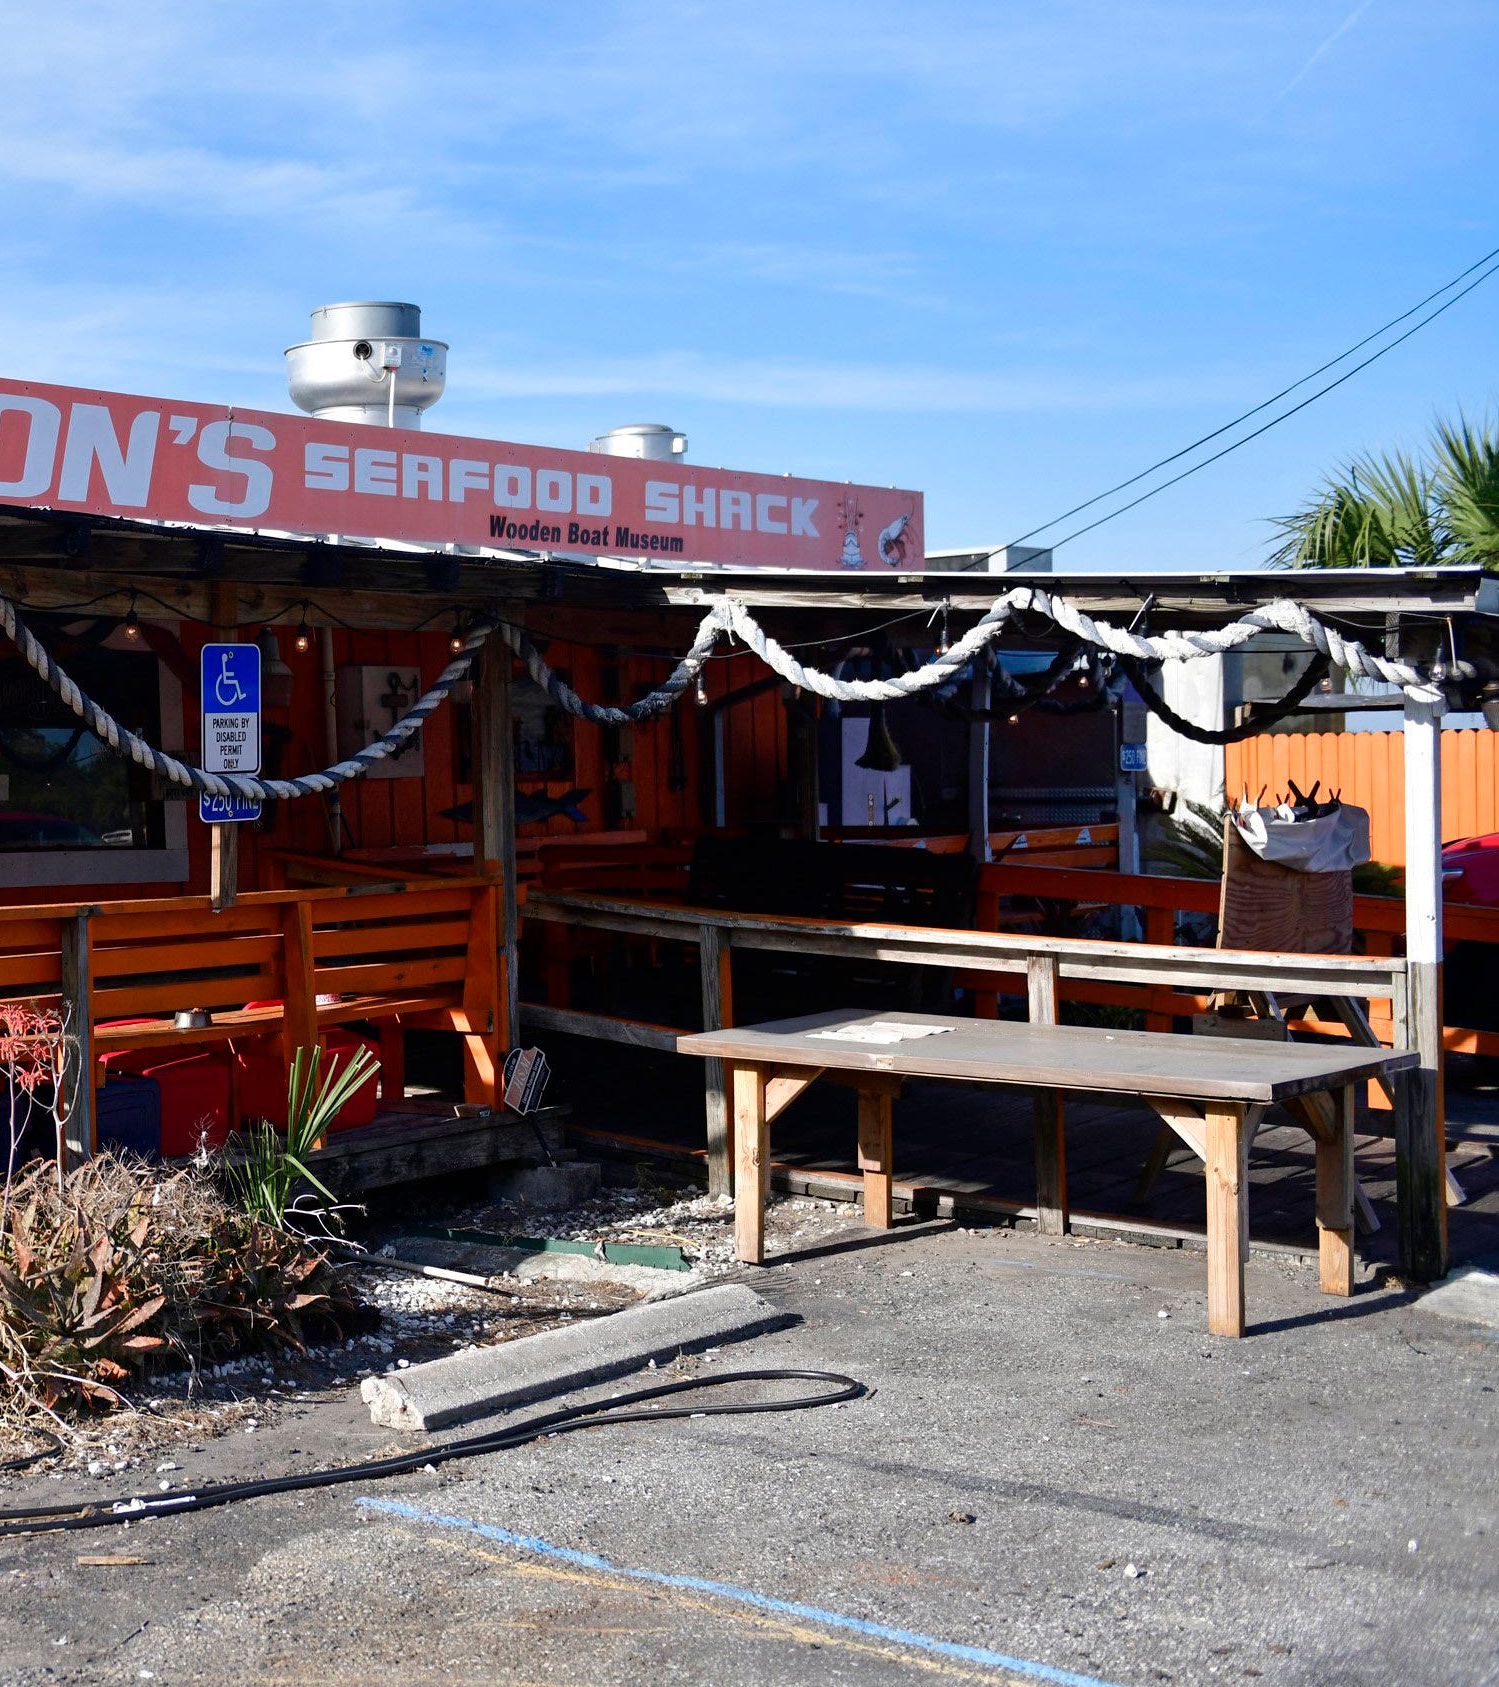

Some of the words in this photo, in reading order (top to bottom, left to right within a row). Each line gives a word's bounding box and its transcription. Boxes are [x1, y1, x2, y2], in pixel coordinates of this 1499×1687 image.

[305, 442, 612, 517] SEAFOOD
[645, 480, 820, 537] SHACK
[489, 515, 561, 543] Wooden
[567, 522, 609, 547] Boat
[615, 527, 684, 552] Museum
[213, 718, 239, 729] PARKING
[241, 718, 250, 728] BY
[216, 731, 247, 742] DISABLED
[220, 745, 242, 756] PERMIT
